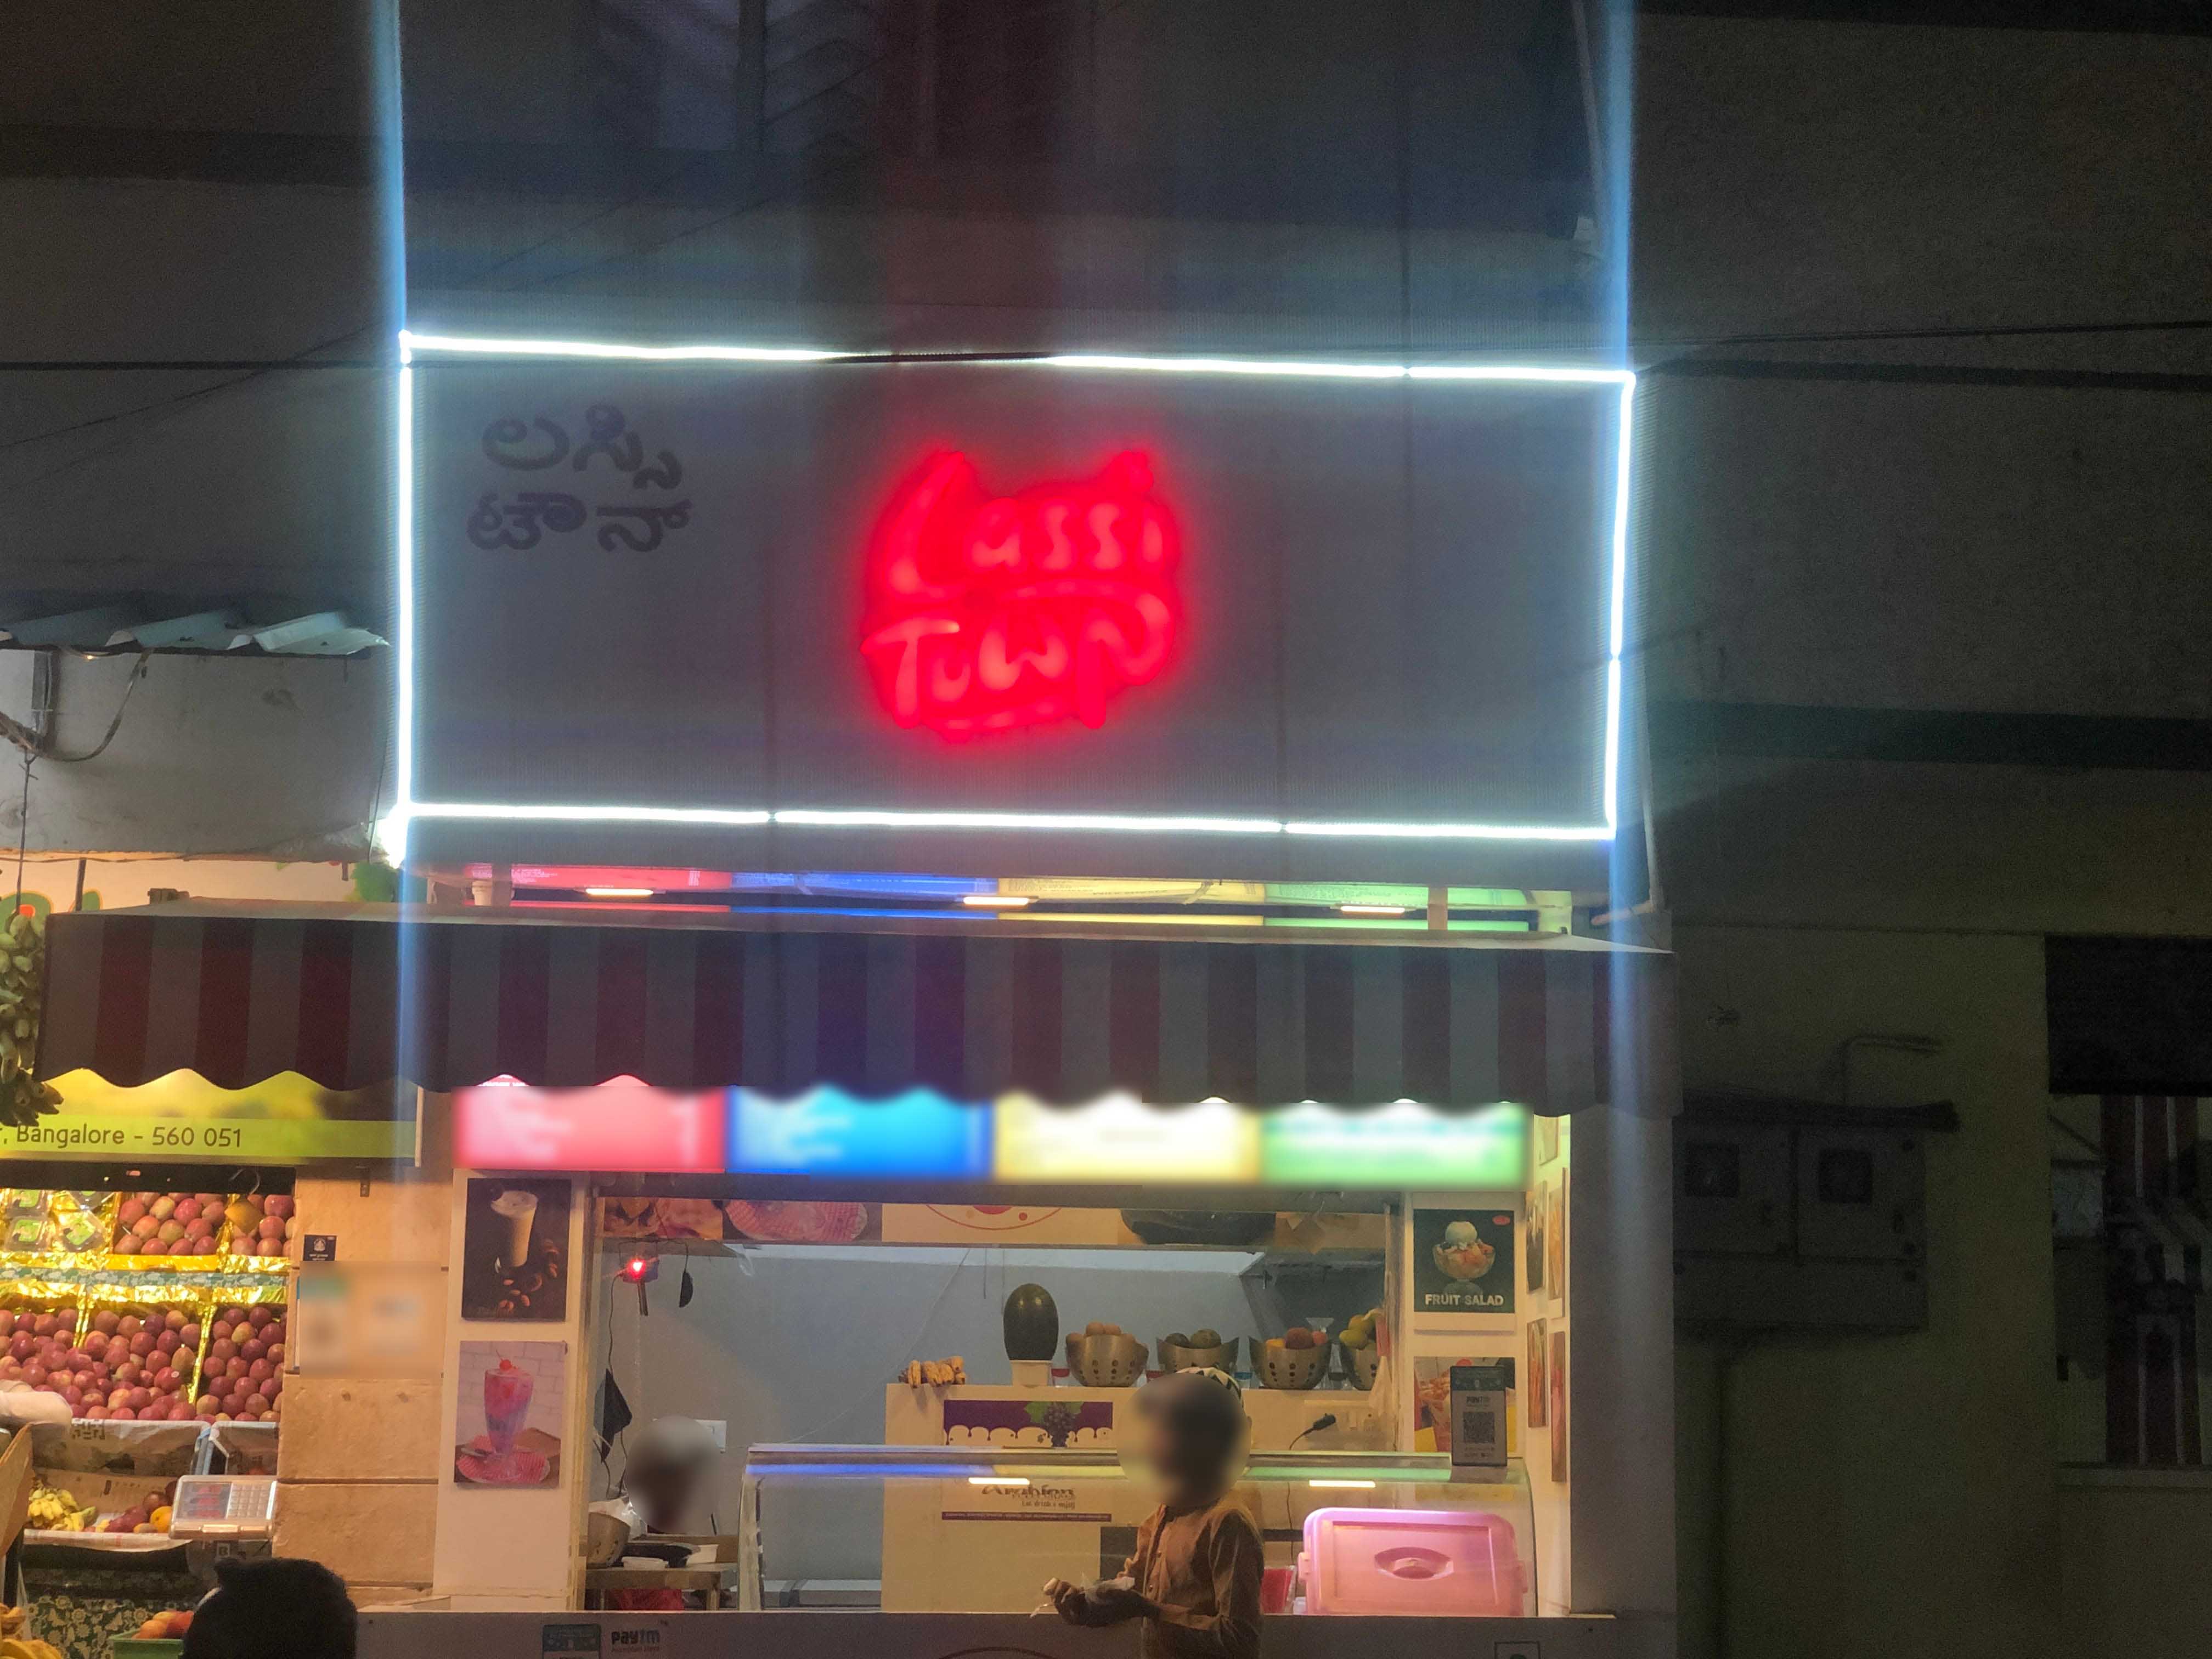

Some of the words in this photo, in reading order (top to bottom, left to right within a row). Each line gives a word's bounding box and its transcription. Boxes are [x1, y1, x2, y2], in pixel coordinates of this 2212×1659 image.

[17, 1123, 125, 1149] Bangalore
[152, 1126, 195, 1146] 560
[204, 1127, 241, 1148] 051
[1425, 1294, 1460, 1306] FRUIT
[1464, 1294, 1504, 1306] SALAD
